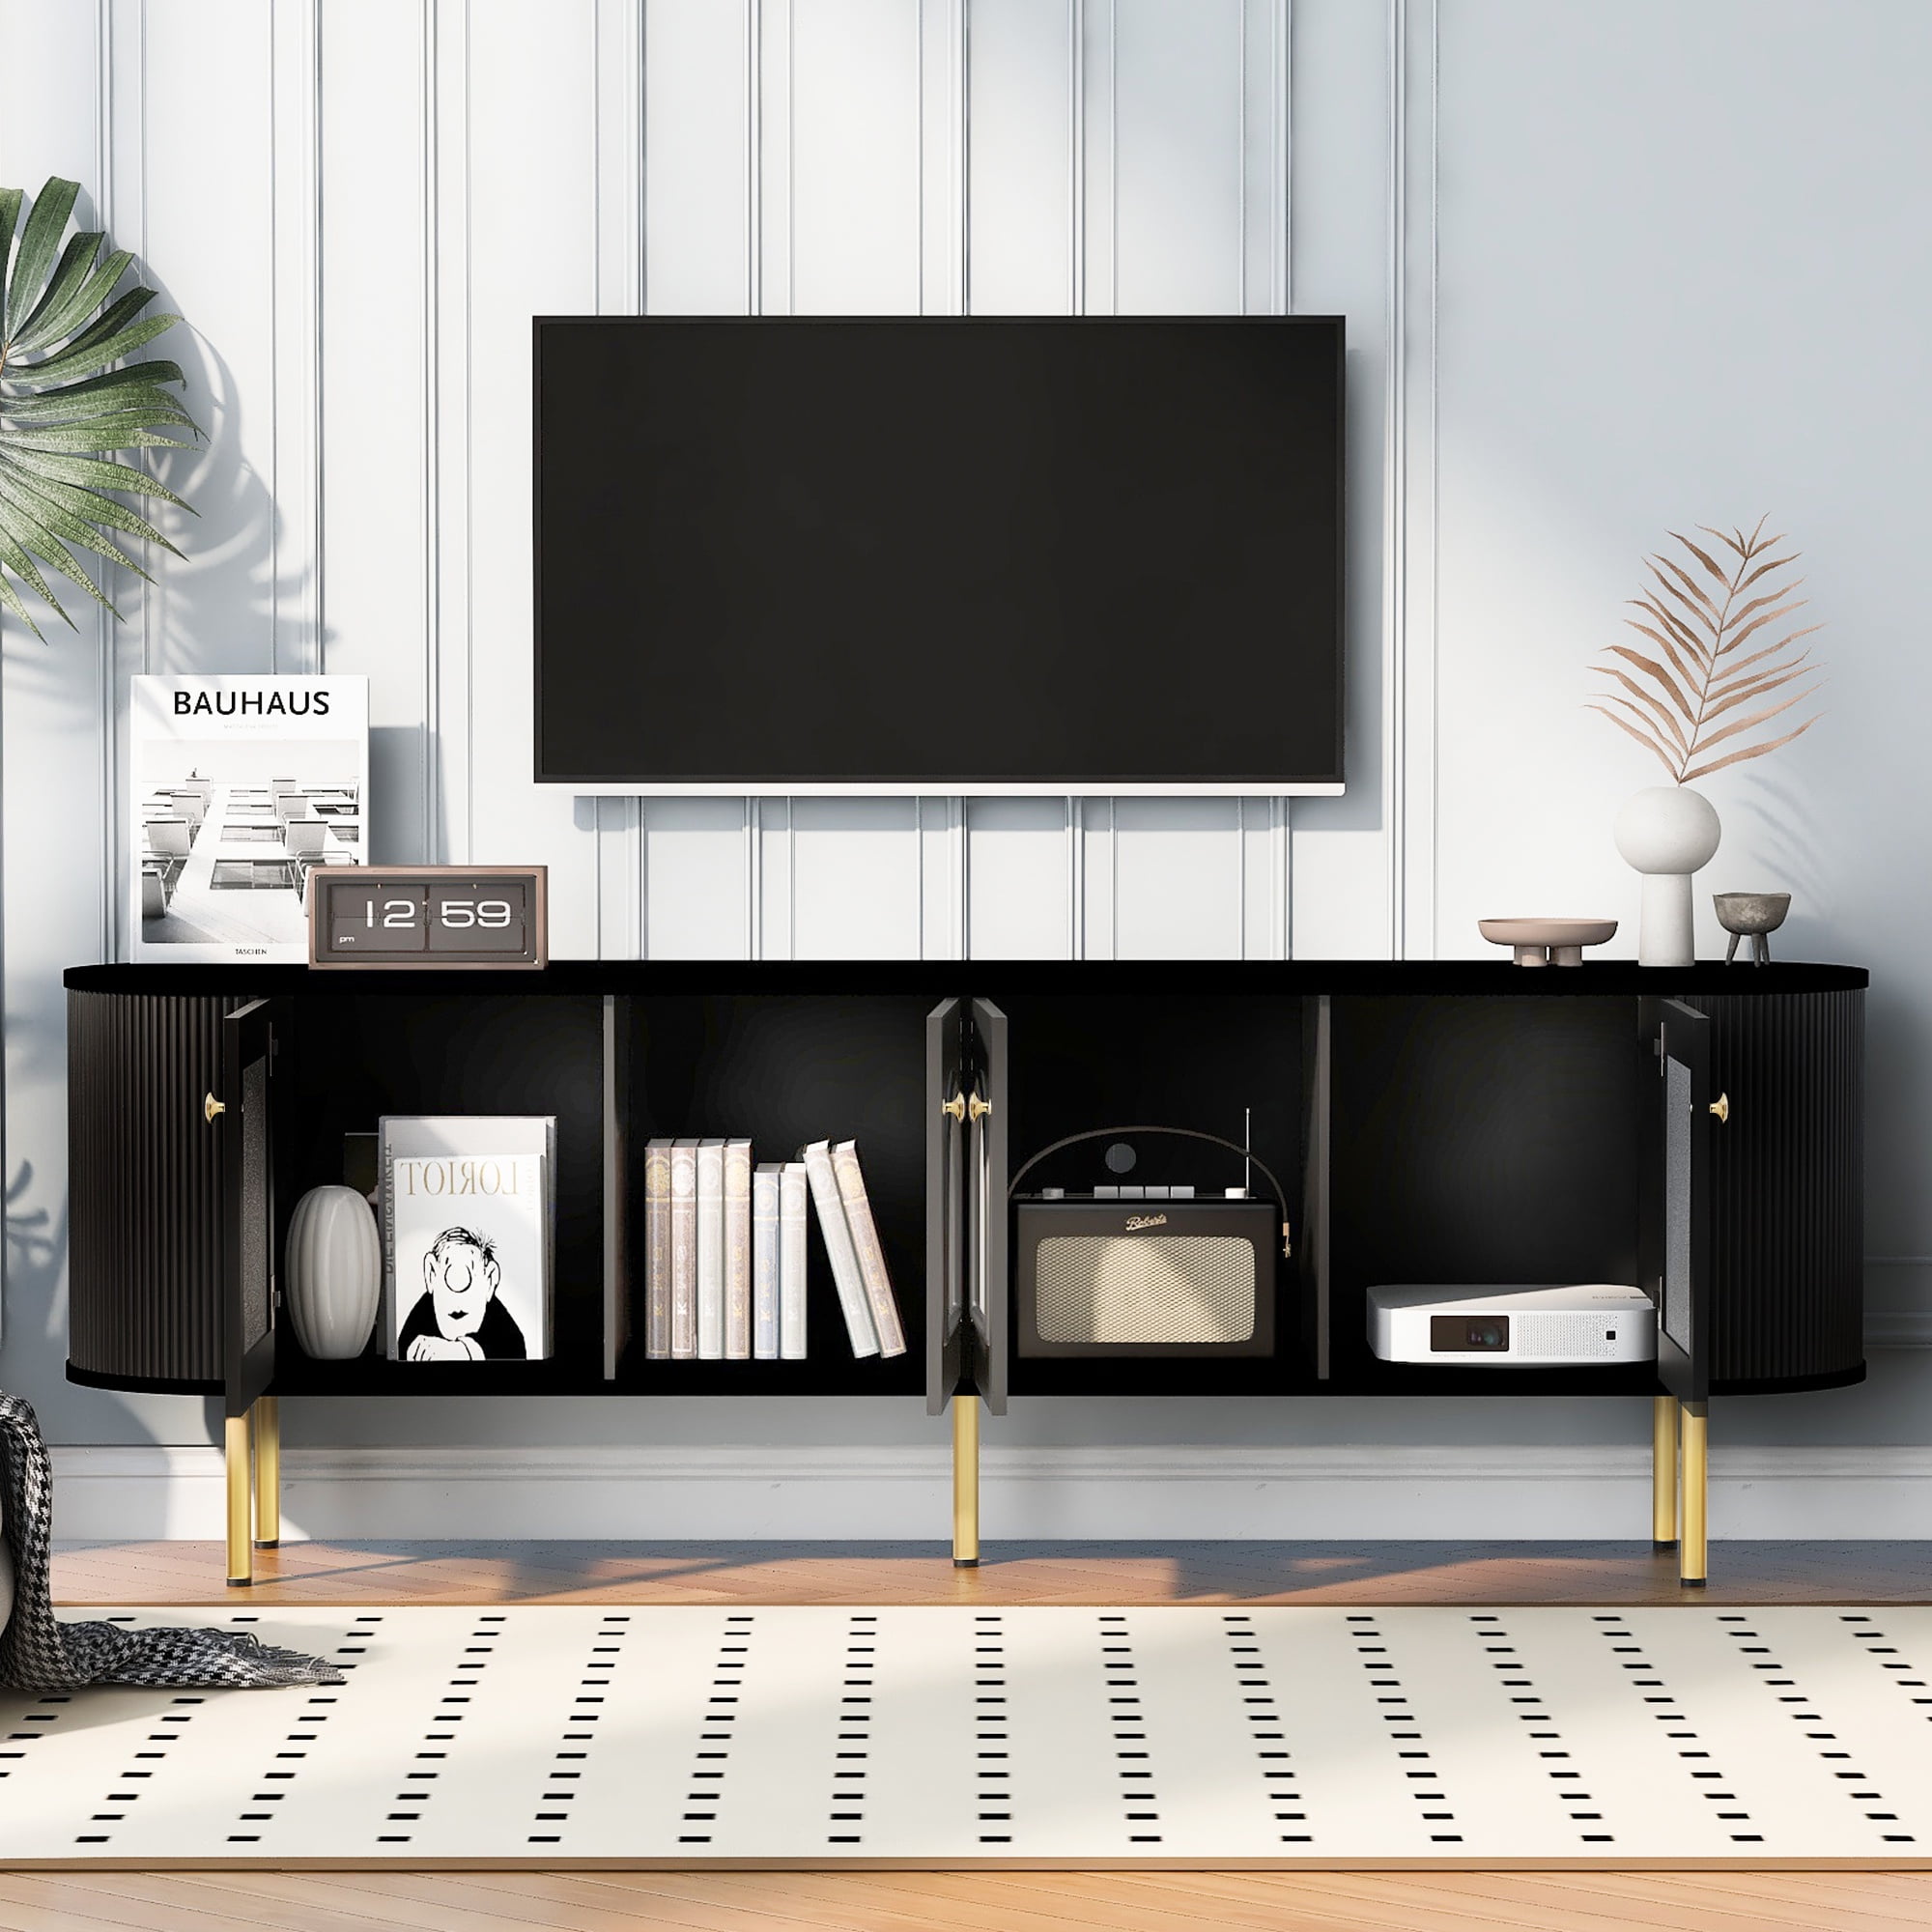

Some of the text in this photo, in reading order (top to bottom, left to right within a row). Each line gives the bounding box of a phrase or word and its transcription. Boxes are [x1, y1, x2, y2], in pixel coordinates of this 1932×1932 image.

[174, 691, 329, 716] BAUHAUS
[365, 899, 512, 928] 12 59
[339, 935, 355, 944] pm
[1125, 1213, 1168, 1232] Roberts
